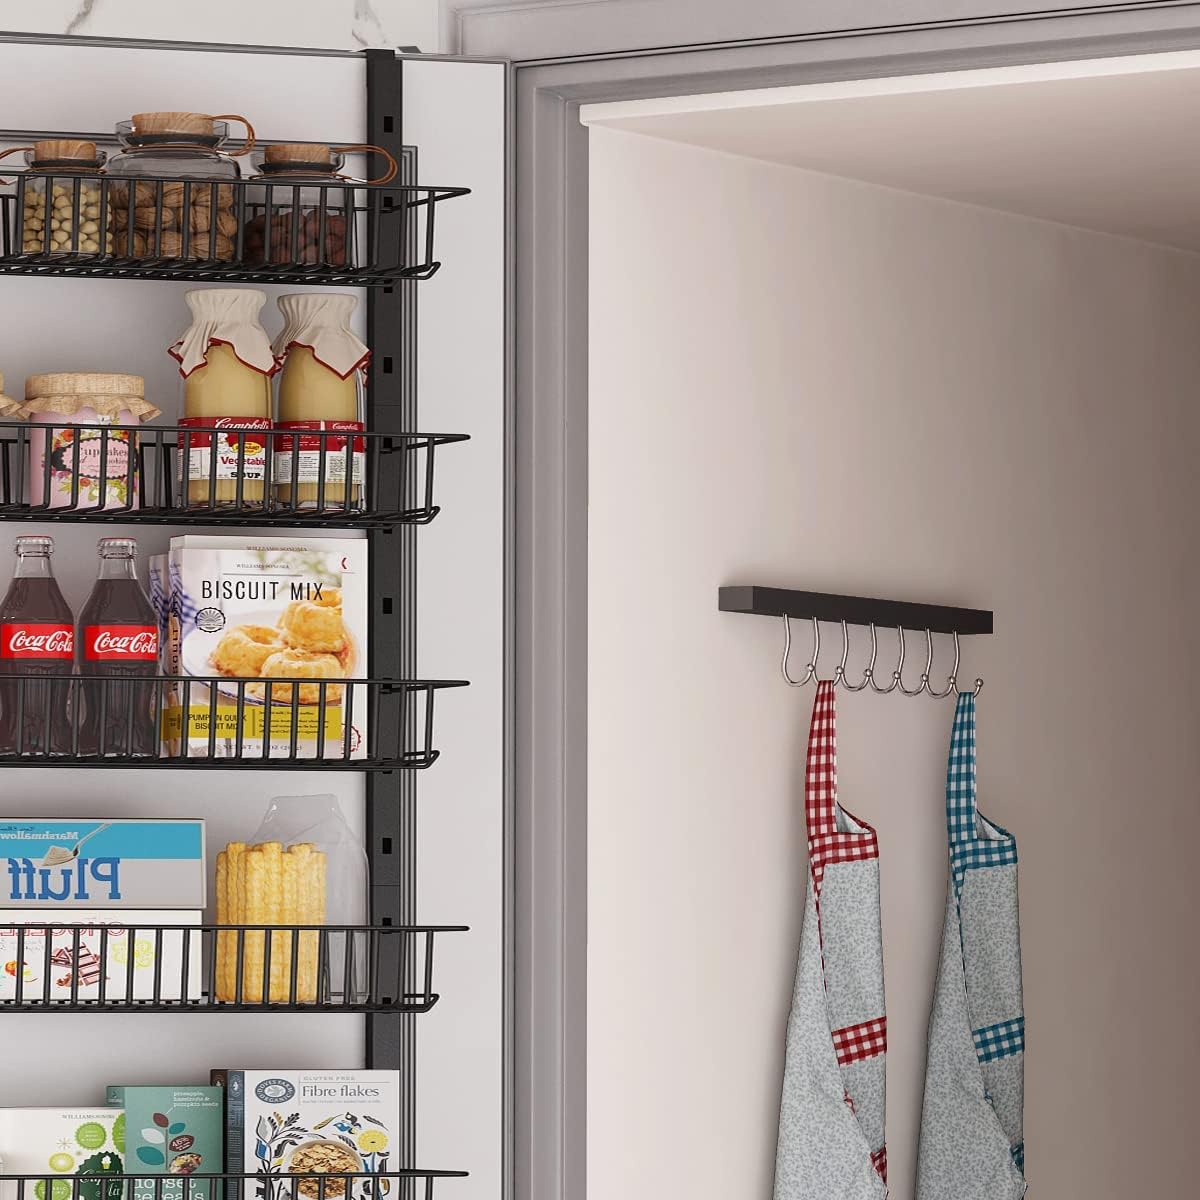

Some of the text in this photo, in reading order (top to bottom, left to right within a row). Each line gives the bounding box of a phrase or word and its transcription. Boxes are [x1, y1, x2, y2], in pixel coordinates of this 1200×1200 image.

[201, 580, 324, 601] BISCUIT MIX
[9, 630, 73, 653] Coca-Cola
[93, 631, 157, 654] Coca-Cola
[302, 1085, 380, 1097] Fibre flakes
